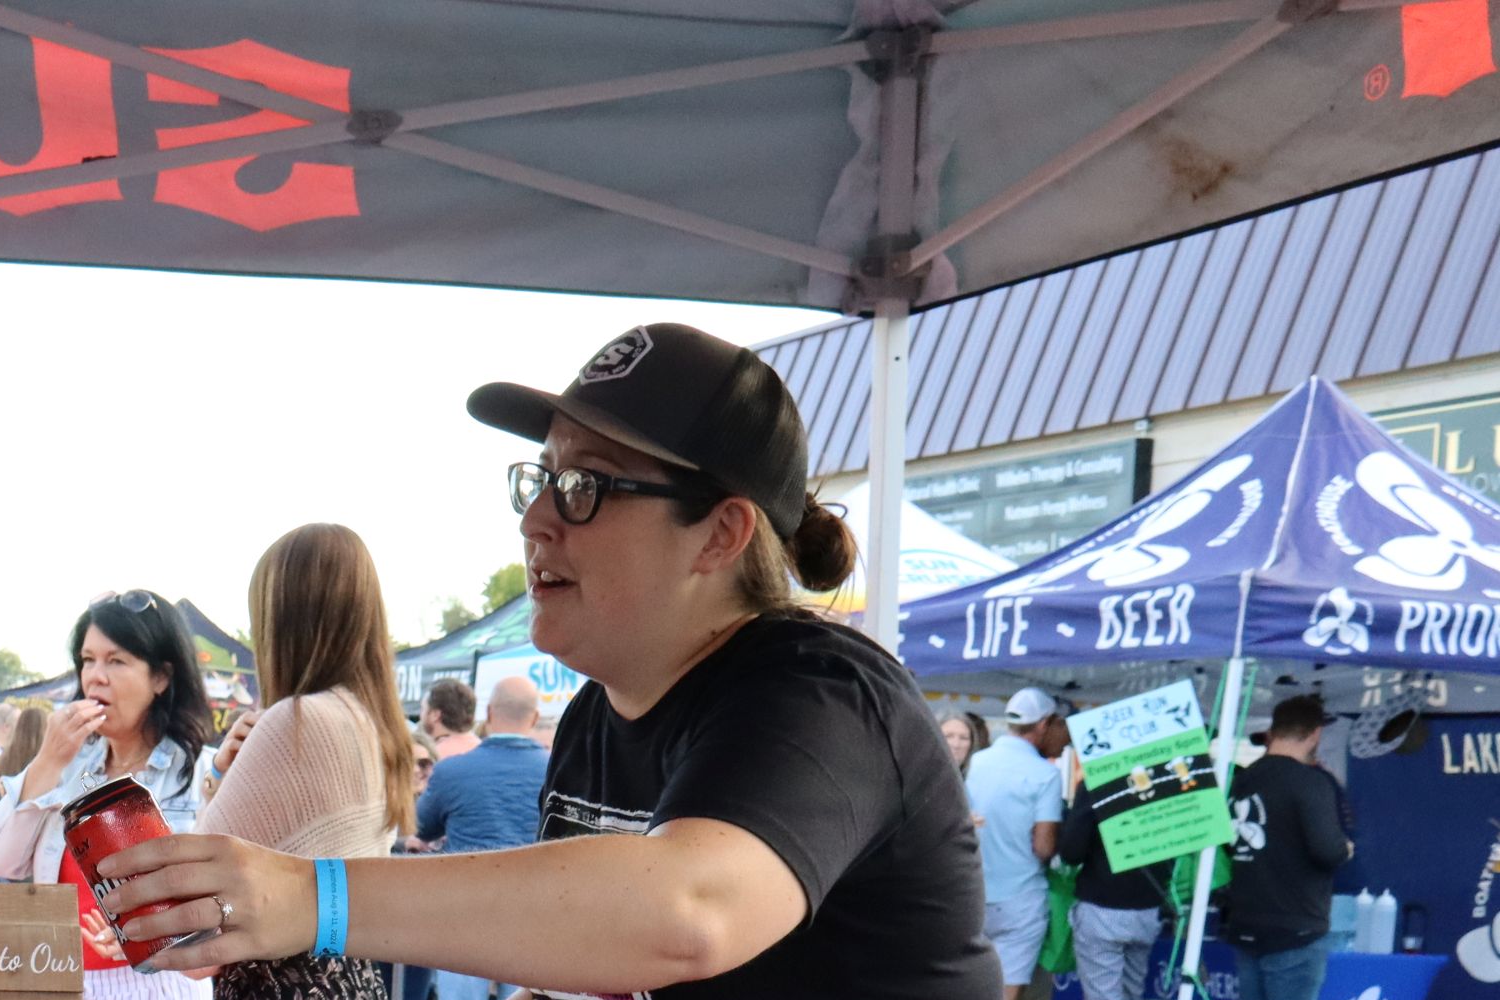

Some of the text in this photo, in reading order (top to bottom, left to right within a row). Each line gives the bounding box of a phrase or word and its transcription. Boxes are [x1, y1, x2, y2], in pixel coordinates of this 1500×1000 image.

[963, 596, 1033, 660] LIFE
[1096, 582, 1195, 652] BEER
[529, 658, 577, 692] SUN
[1441, 733, 1500, 775] LAK
[30, 942, 81, 975] Our
